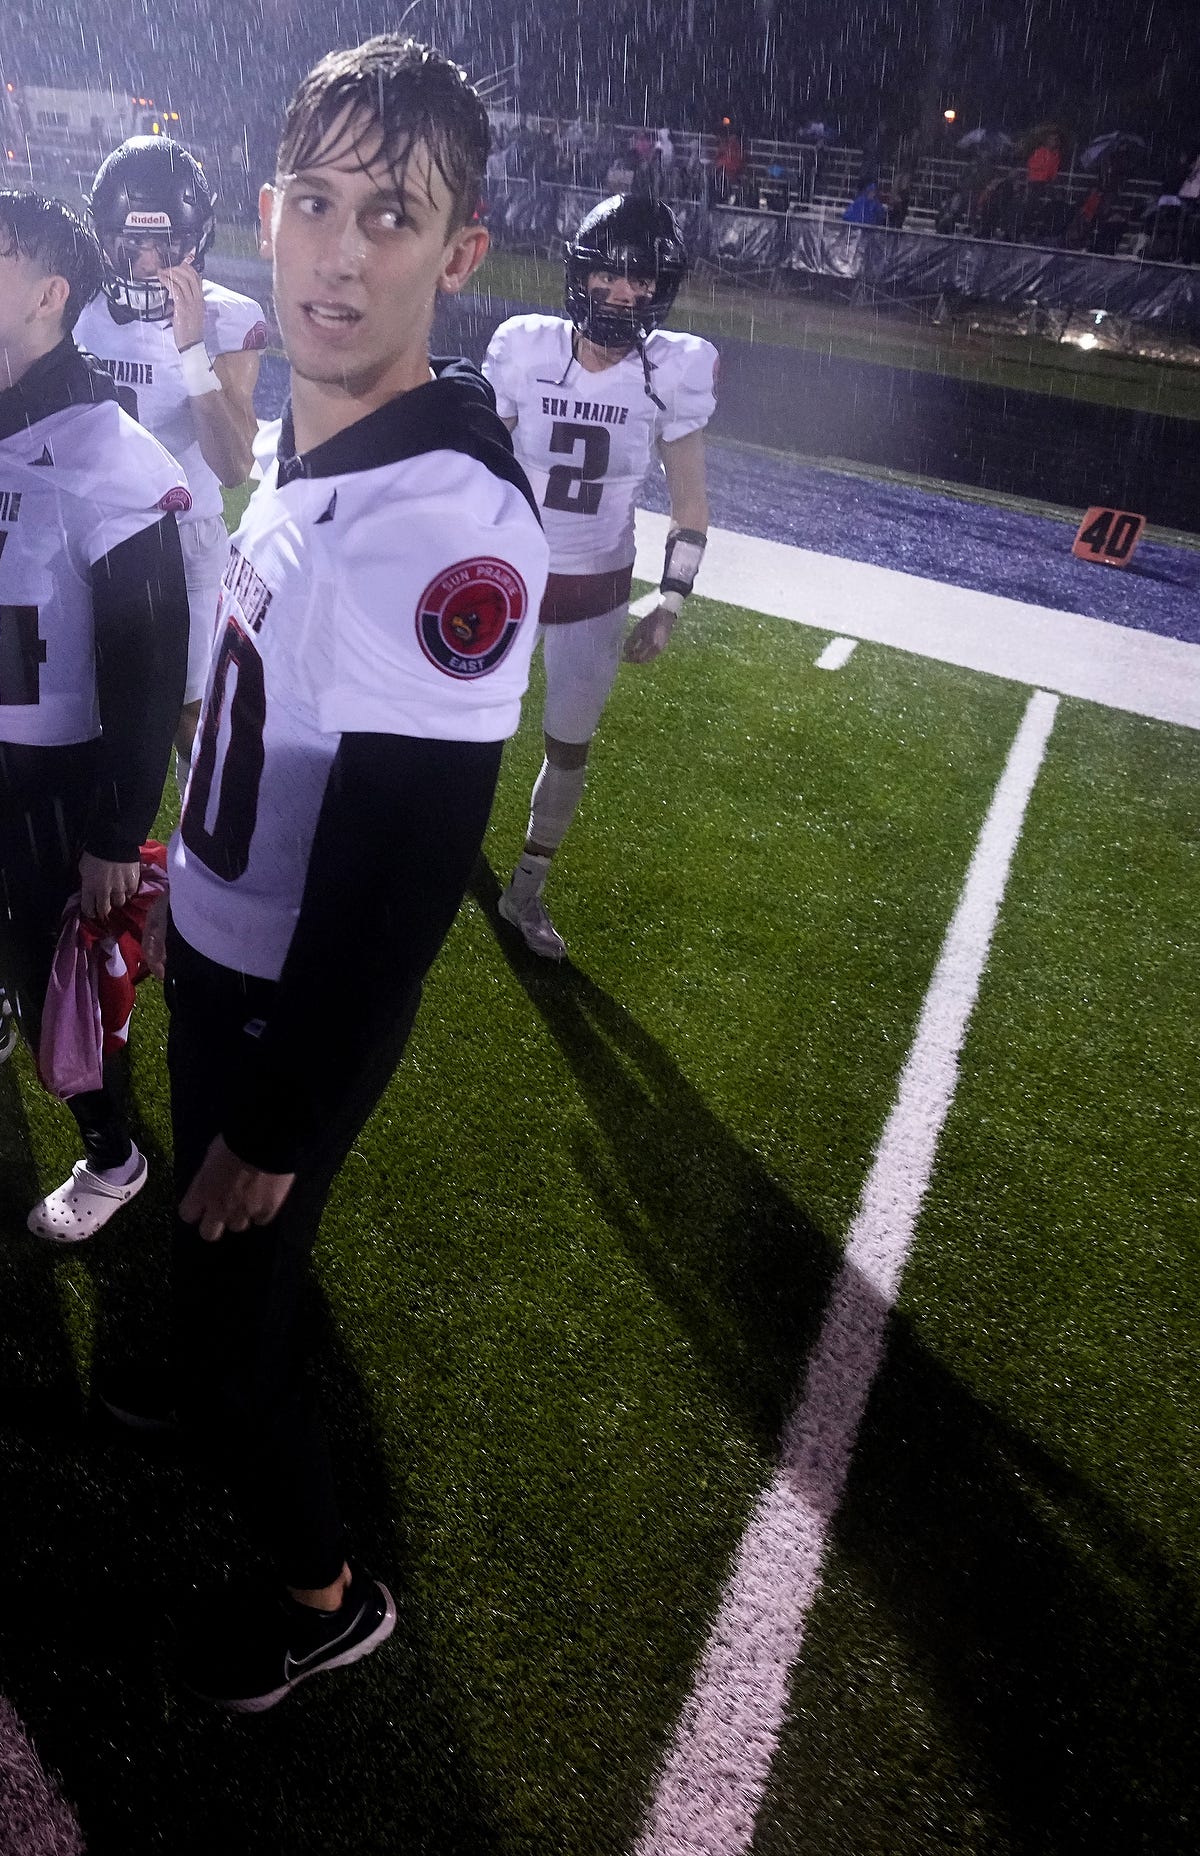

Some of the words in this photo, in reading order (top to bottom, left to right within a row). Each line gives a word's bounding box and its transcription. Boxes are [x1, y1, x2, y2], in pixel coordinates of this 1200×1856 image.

[130, 215, 166, 225] Riddell
[541, 396, 569, 418] SUN
[573, 401, 630, 426] PRAIRIE
[543, 421, 611, 516] 2
[1080, 510, 1142, 559] 40
[448, 656, 485, 672] EAST
[179, 590, 267, 884] 0
